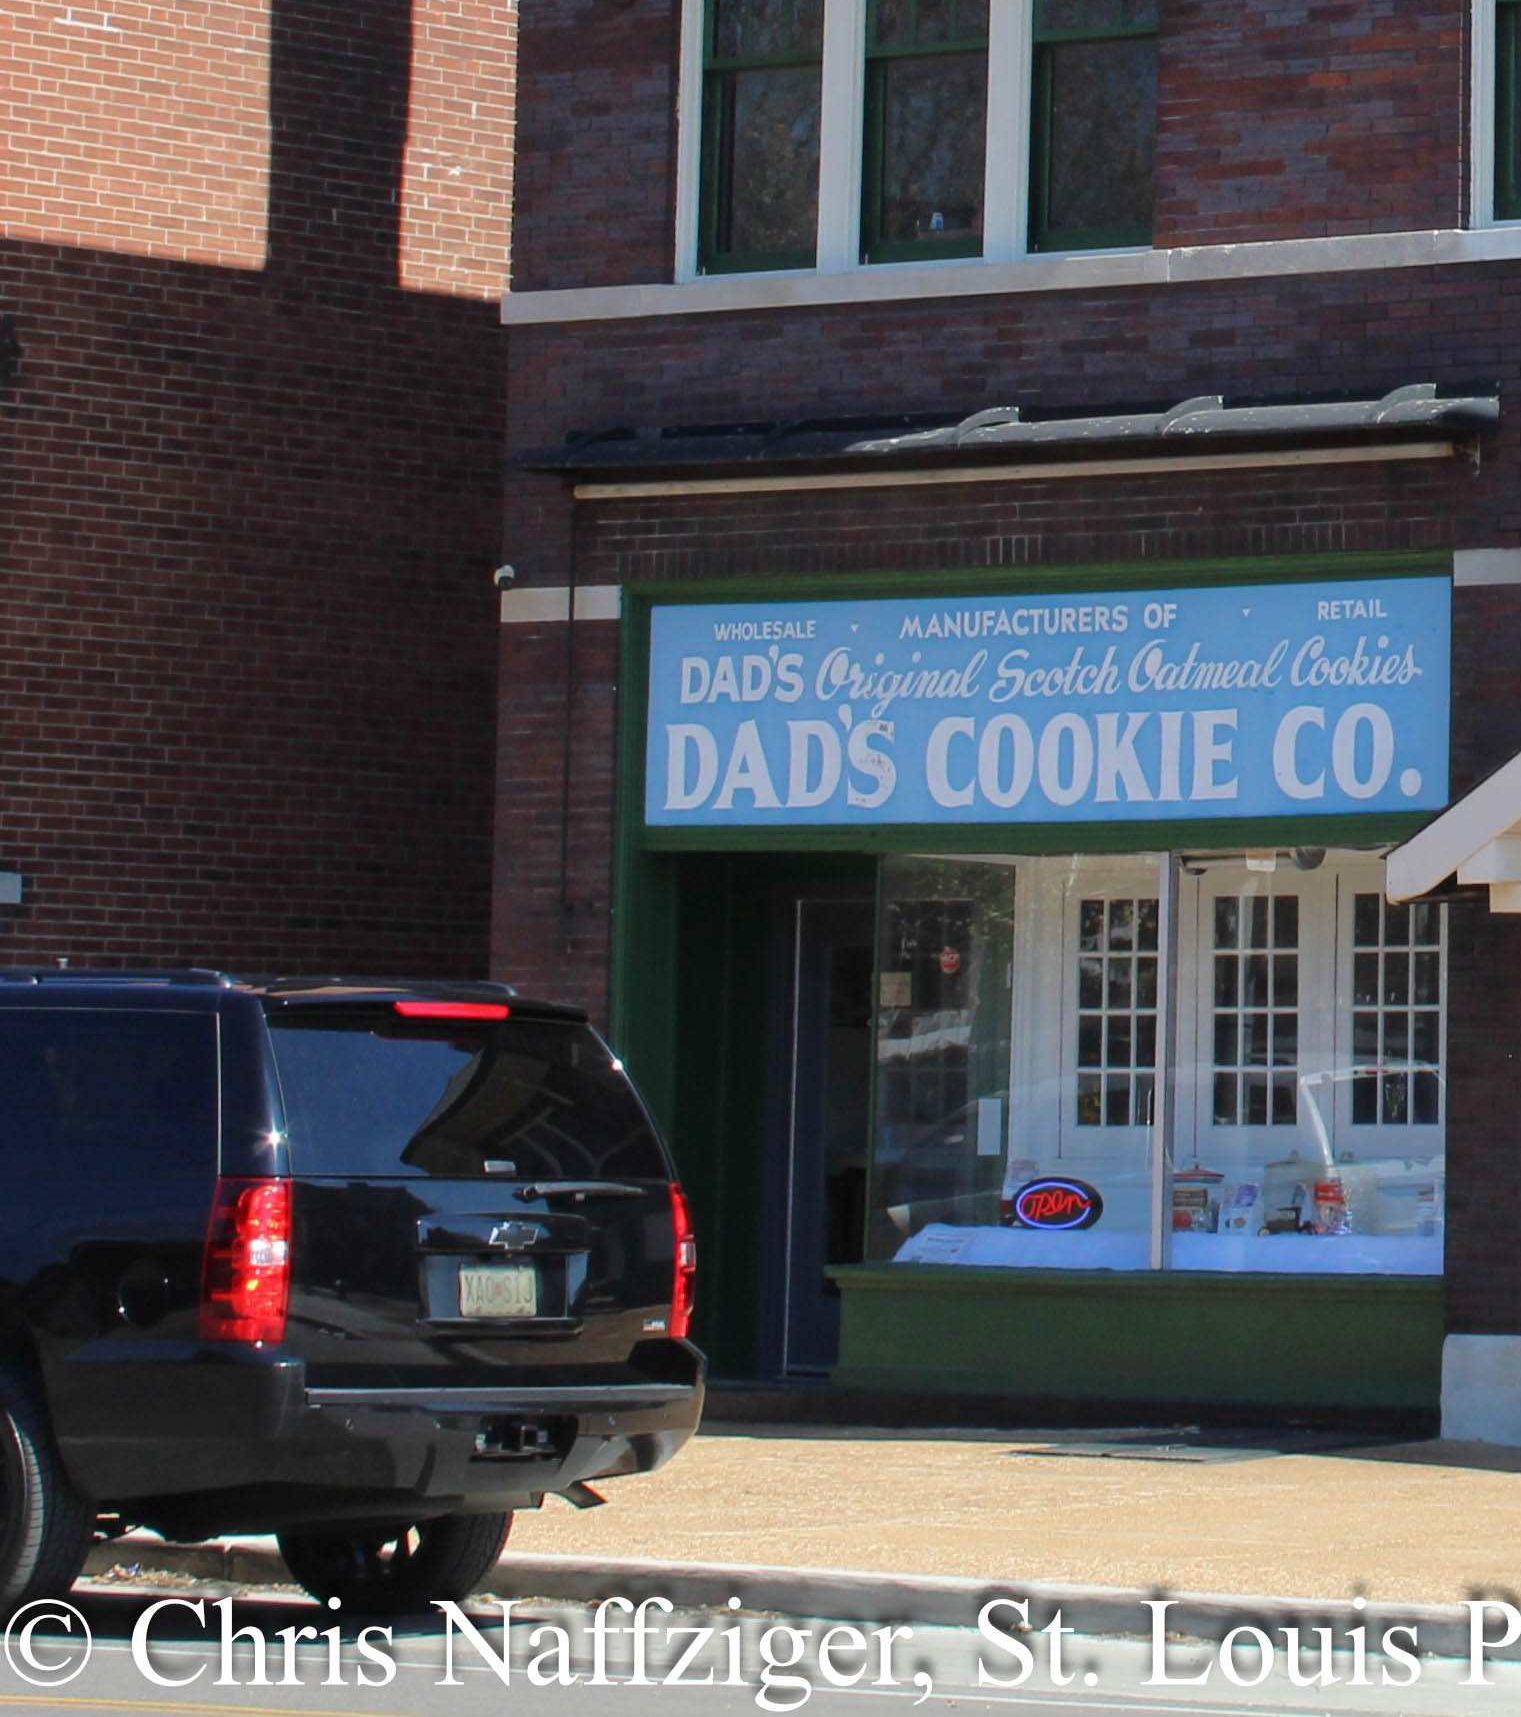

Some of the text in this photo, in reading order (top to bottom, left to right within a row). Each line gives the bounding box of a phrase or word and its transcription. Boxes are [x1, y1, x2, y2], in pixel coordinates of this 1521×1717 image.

[714, 599, 1388, 641] WHOLESALE MANUFACTURERS OF RETAIL
[680, 635, 1423, 719] DAD'S Original Scotch Oatmeal Cookies
[663, 703, 1422, 810] DAD'S COOKIE CO.
